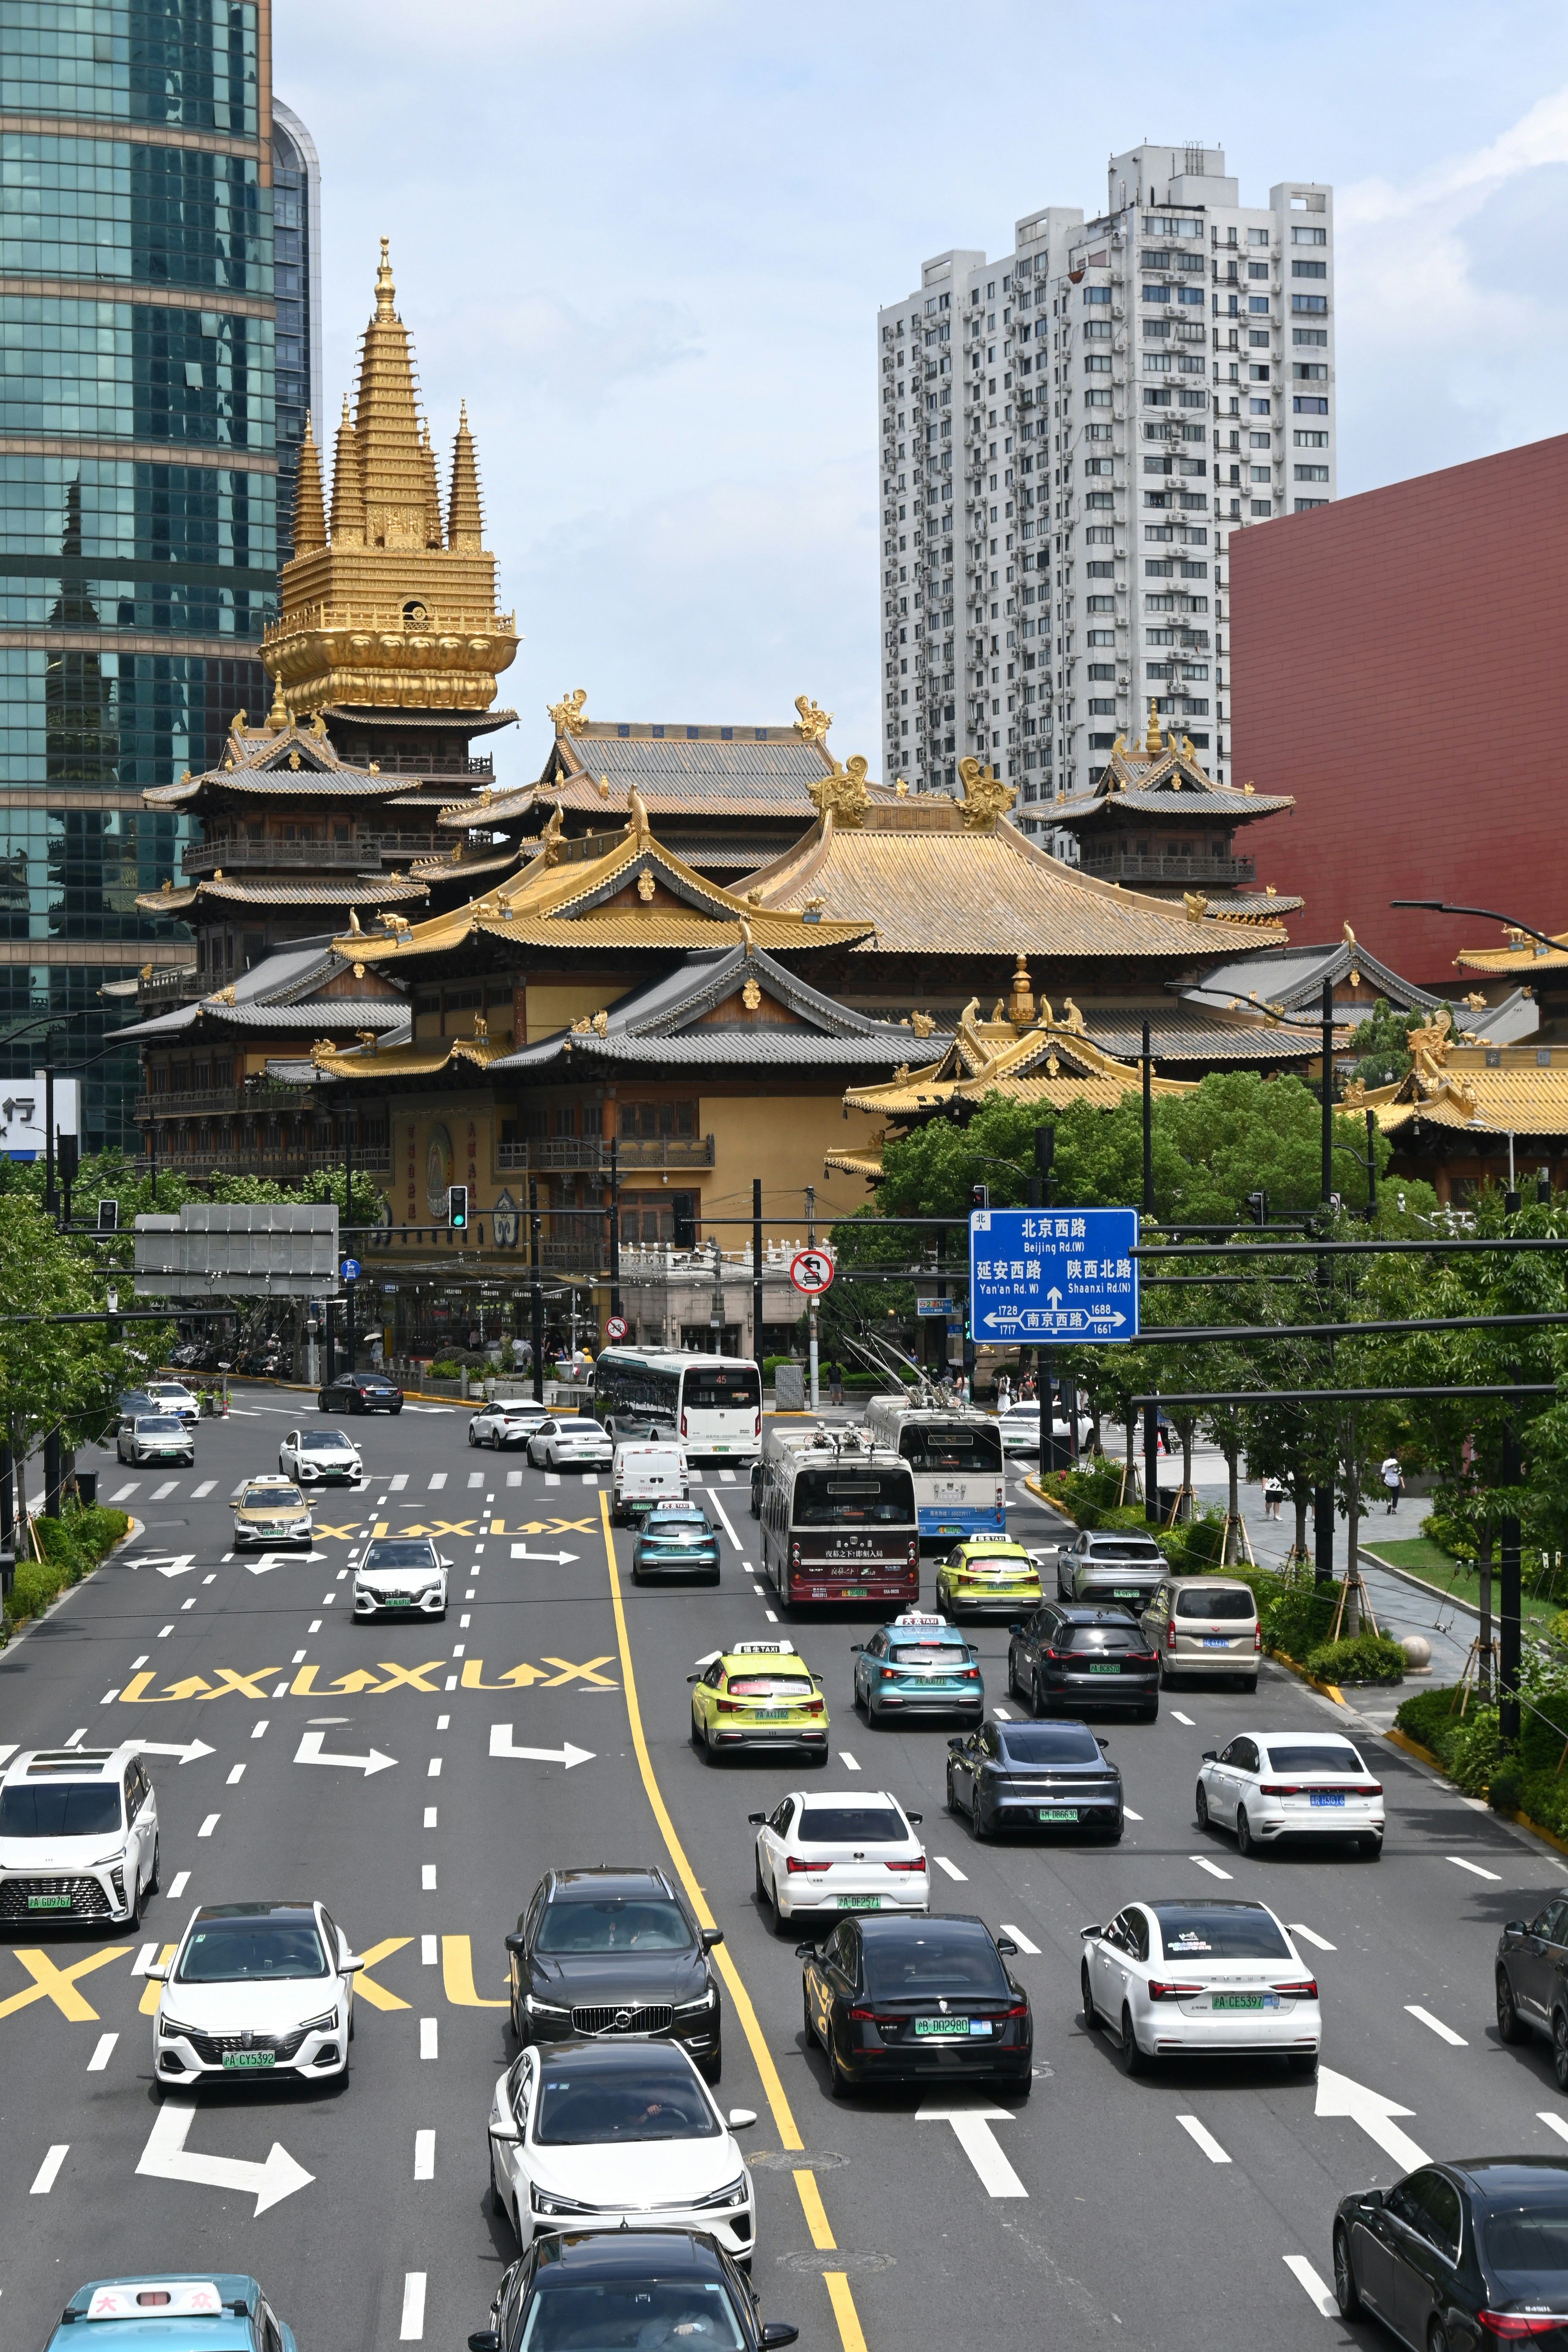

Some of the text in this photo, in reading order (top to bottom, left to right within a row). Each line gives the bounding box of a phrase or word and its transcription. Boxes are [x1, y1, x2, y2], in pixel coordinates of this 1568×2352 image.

[2, 1097, 35, 1122] 行
[976, 1214, 985, 1223] 北
[1022, 1218, 1086, 1238] 北京西路
[1024, 1242, 1084, 1255] Beijing Rd.(W)
[977, 1260, 1042, 1280] 延安西路
[1067, 1258, 1132, 1279] 陕西北路
[980, 1284, 1010, 1294] Yan'an
[1068, 1283, 1131, 1293] Shaanxi Rd.(N)
[999, 1306, 1018, 1316] 1728
[1092, 1305, 1111, 1315] 1688
[1027, 1313, 1083, 1327] 南京西路
[1000, 1325, 1016, 1335] 1717
[1094, 1324, 1111, 1334] 1661
[716, 1375, 727, 1384] 45
